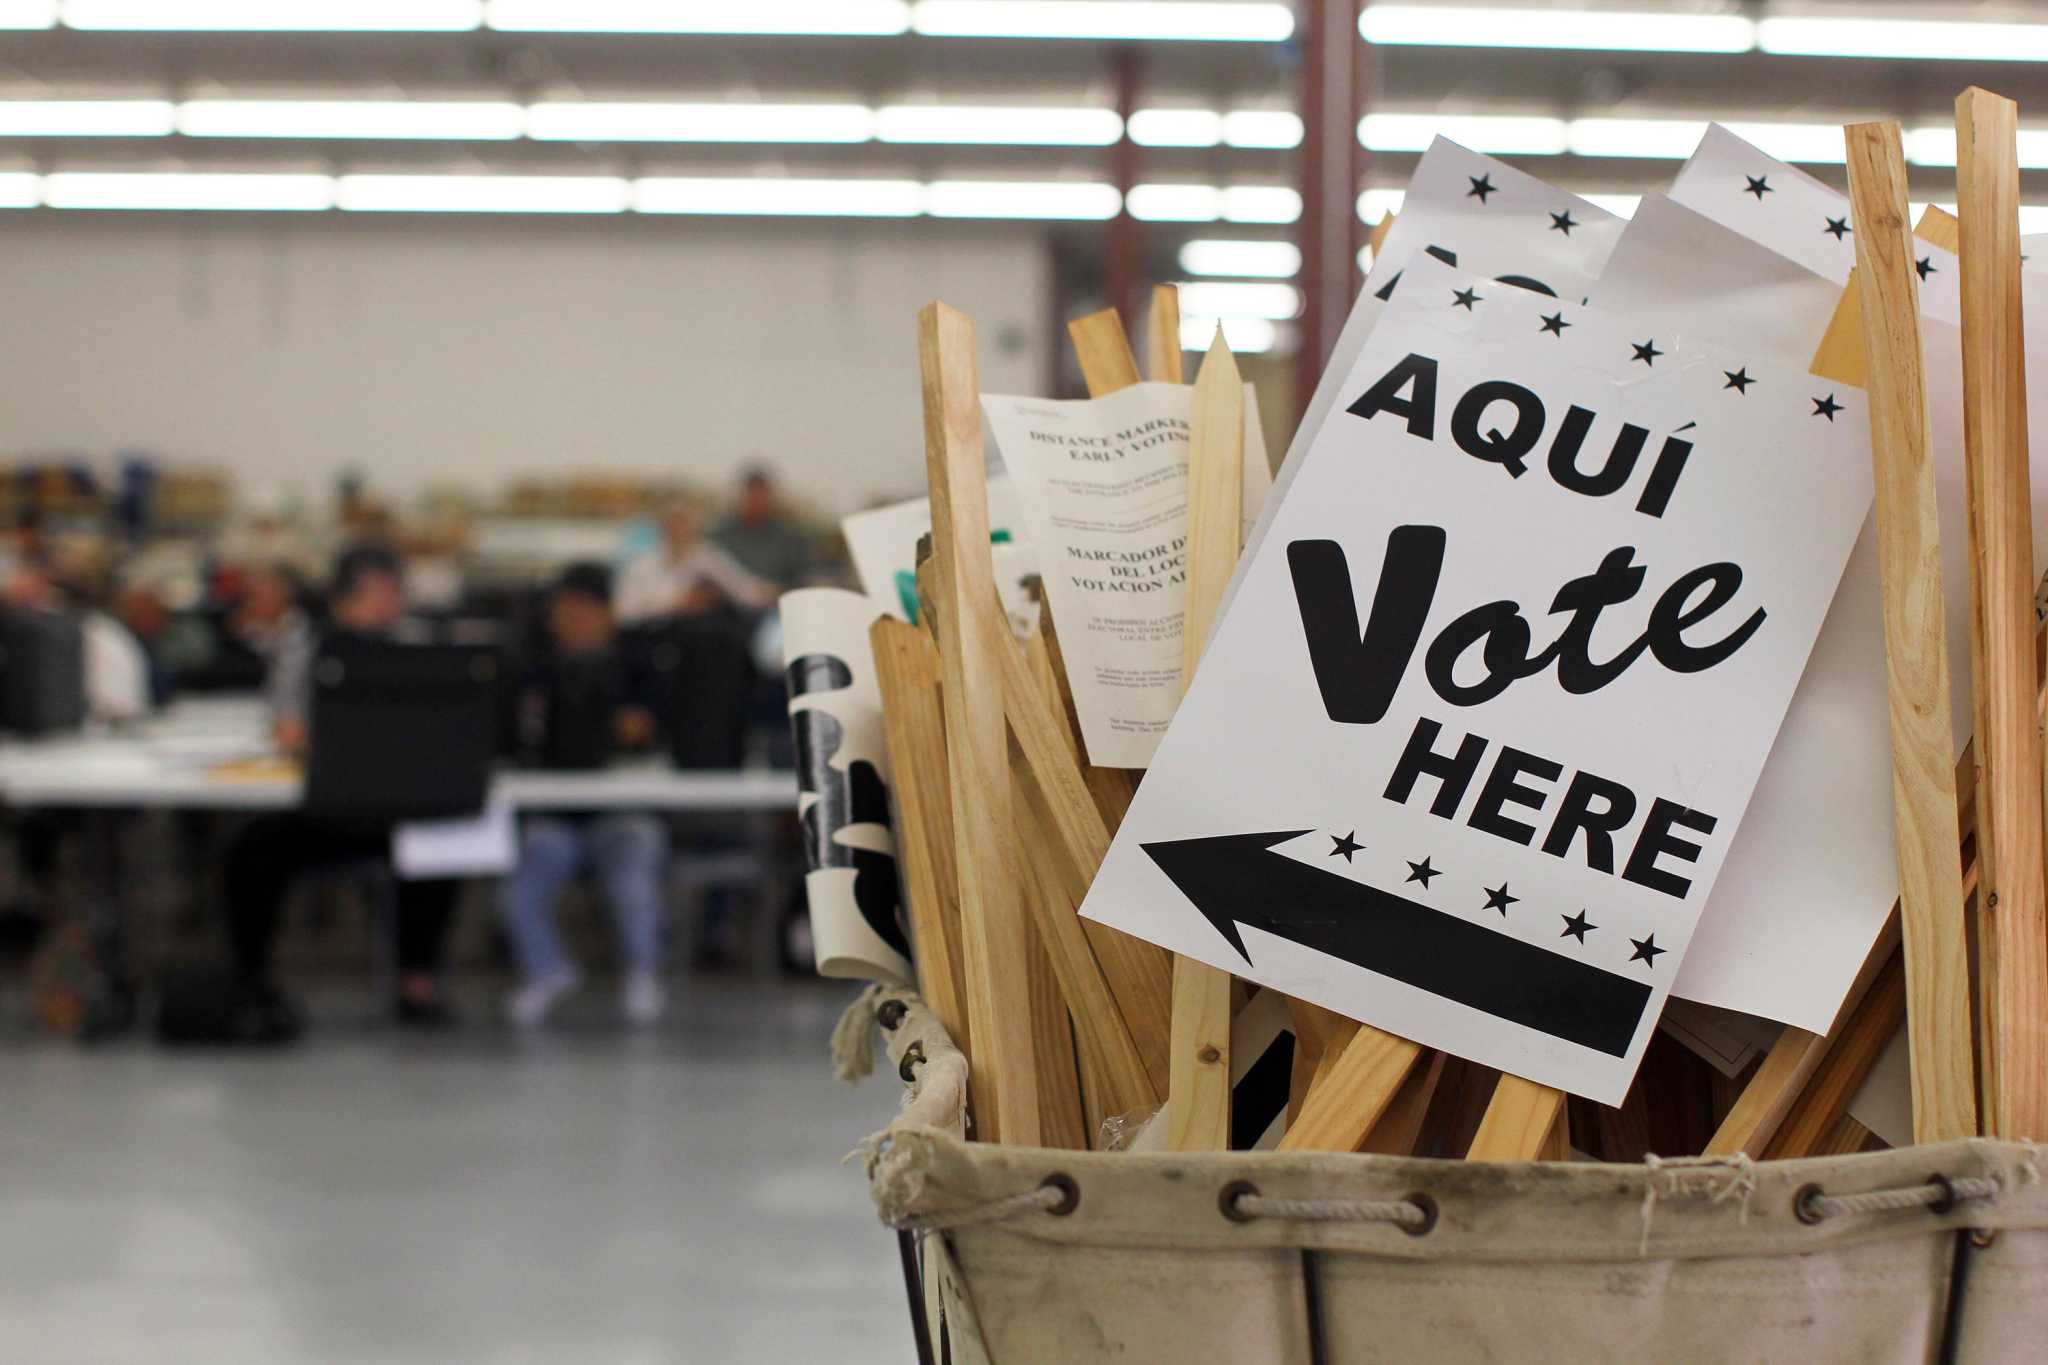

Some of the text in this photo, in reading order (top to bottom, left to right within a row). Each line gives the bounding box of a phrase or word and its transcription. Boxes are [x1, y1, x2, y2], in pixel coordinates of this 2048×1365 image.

[1029, 430, 1113, 448] DISTANCE
[1346, 353, 1697, 519] AQUÍ
[1068, 447, 1125, 462] EARLY
[1067, 545, 1168, 563] MARCADOR
[1110, 566, 1146, 578] DEL
[1071, 576, 1162, 593] VOTACION
[1286, 525, 1767, 725] Vote
[1383, 717, 1718, 900] HERE
